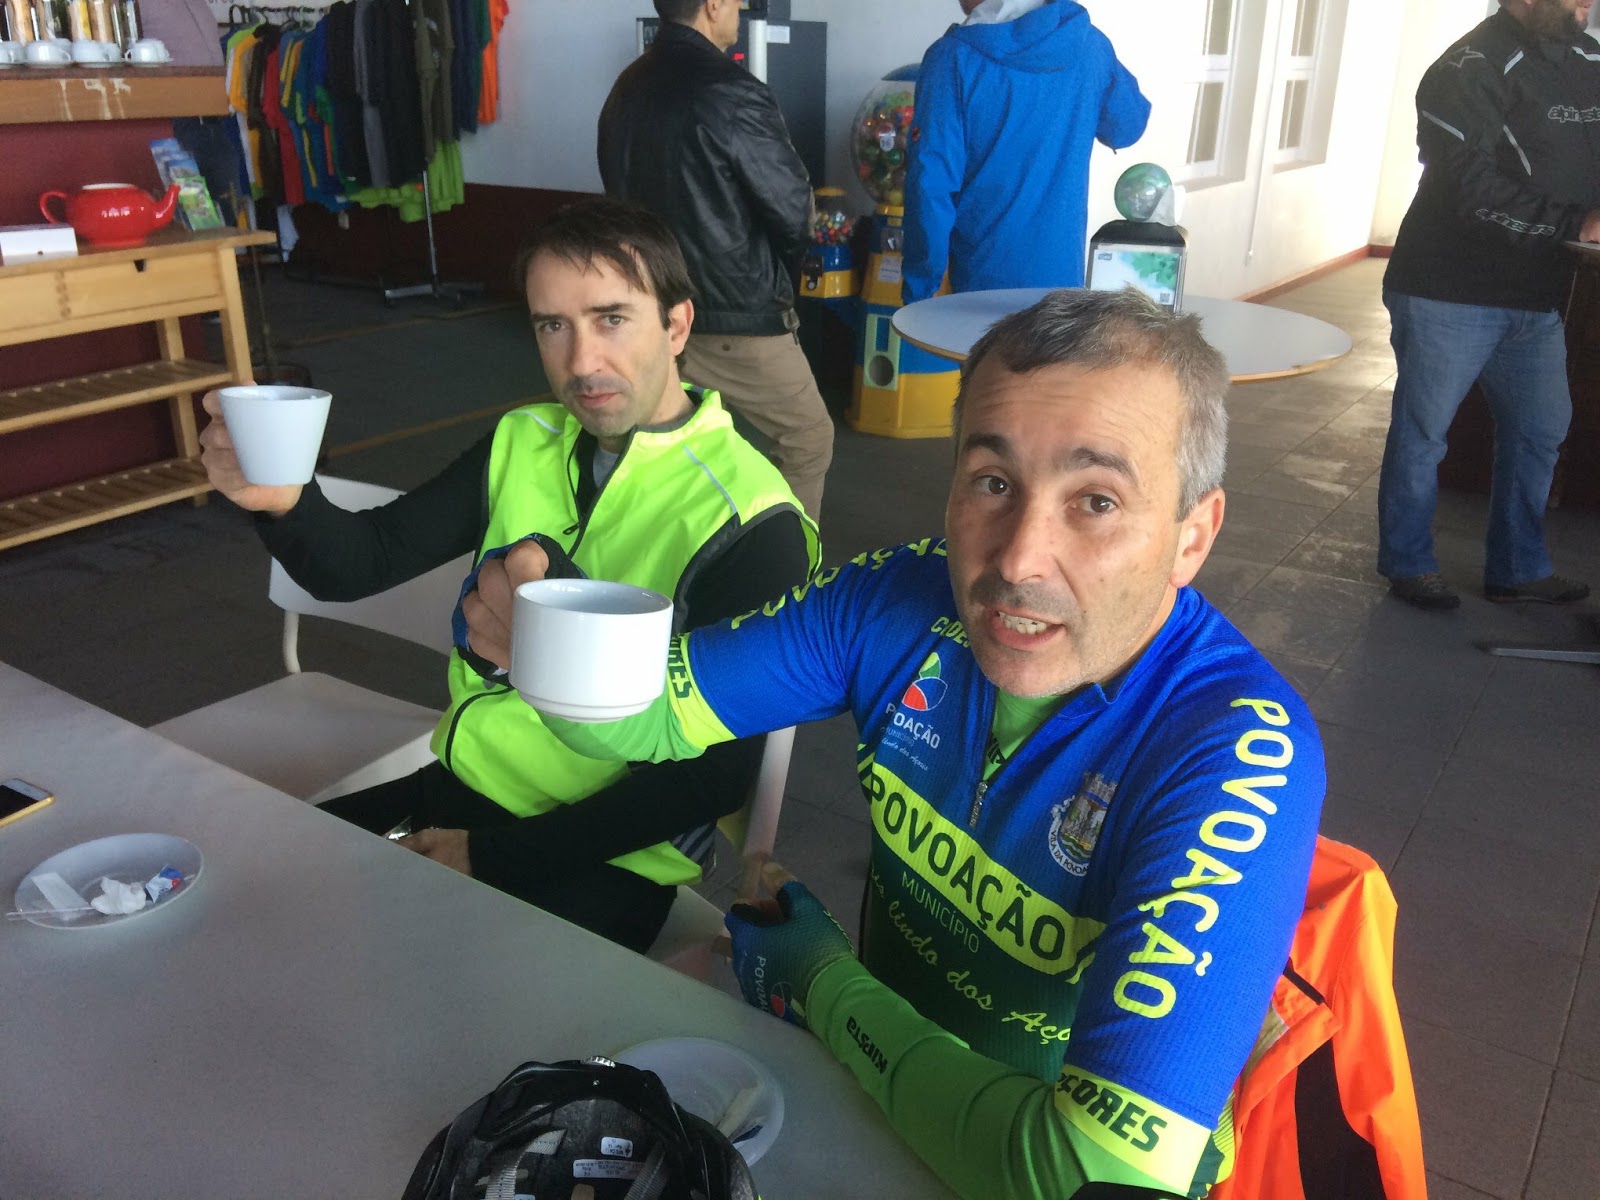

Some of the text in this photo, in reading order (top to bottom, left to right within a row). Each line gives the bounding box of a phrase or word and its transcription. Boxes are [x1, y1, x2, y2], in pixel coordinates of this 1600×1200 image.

[870, 774, 1066, 961] POVOAÇÃO
[902, 870, 980, 953] MUNICÍPIO
[1113, 697, 1294, 1018] POVOAÇÃO
[946, 970, 993, 1010] dos
